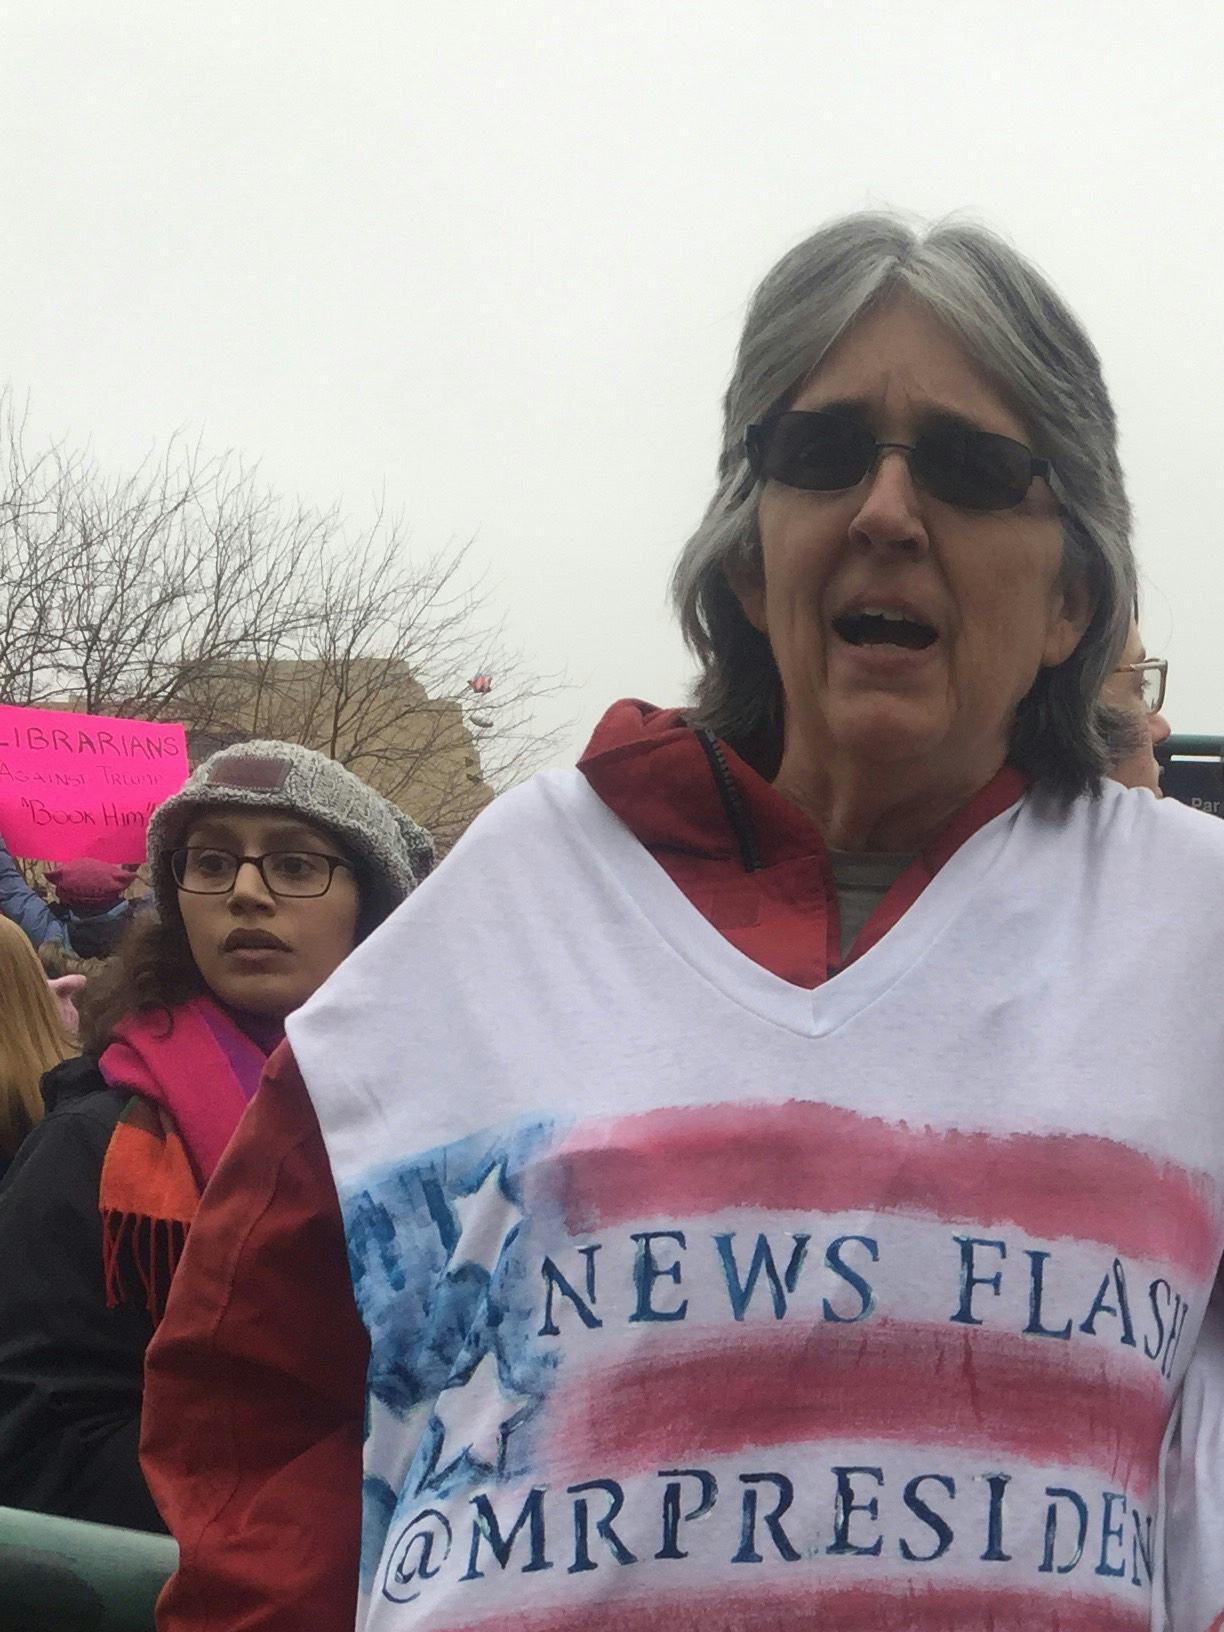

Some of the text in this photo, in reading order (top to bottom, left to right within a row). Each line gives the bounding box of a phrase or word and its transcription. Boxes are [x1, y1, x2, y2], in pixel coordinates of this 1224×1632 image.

[1191, 797, 1221, 813] Par
[538, 1229, 1189, 1379] NEWS FLASH
[382, 1465, 1153, 1604] @MRPRESIDEN
